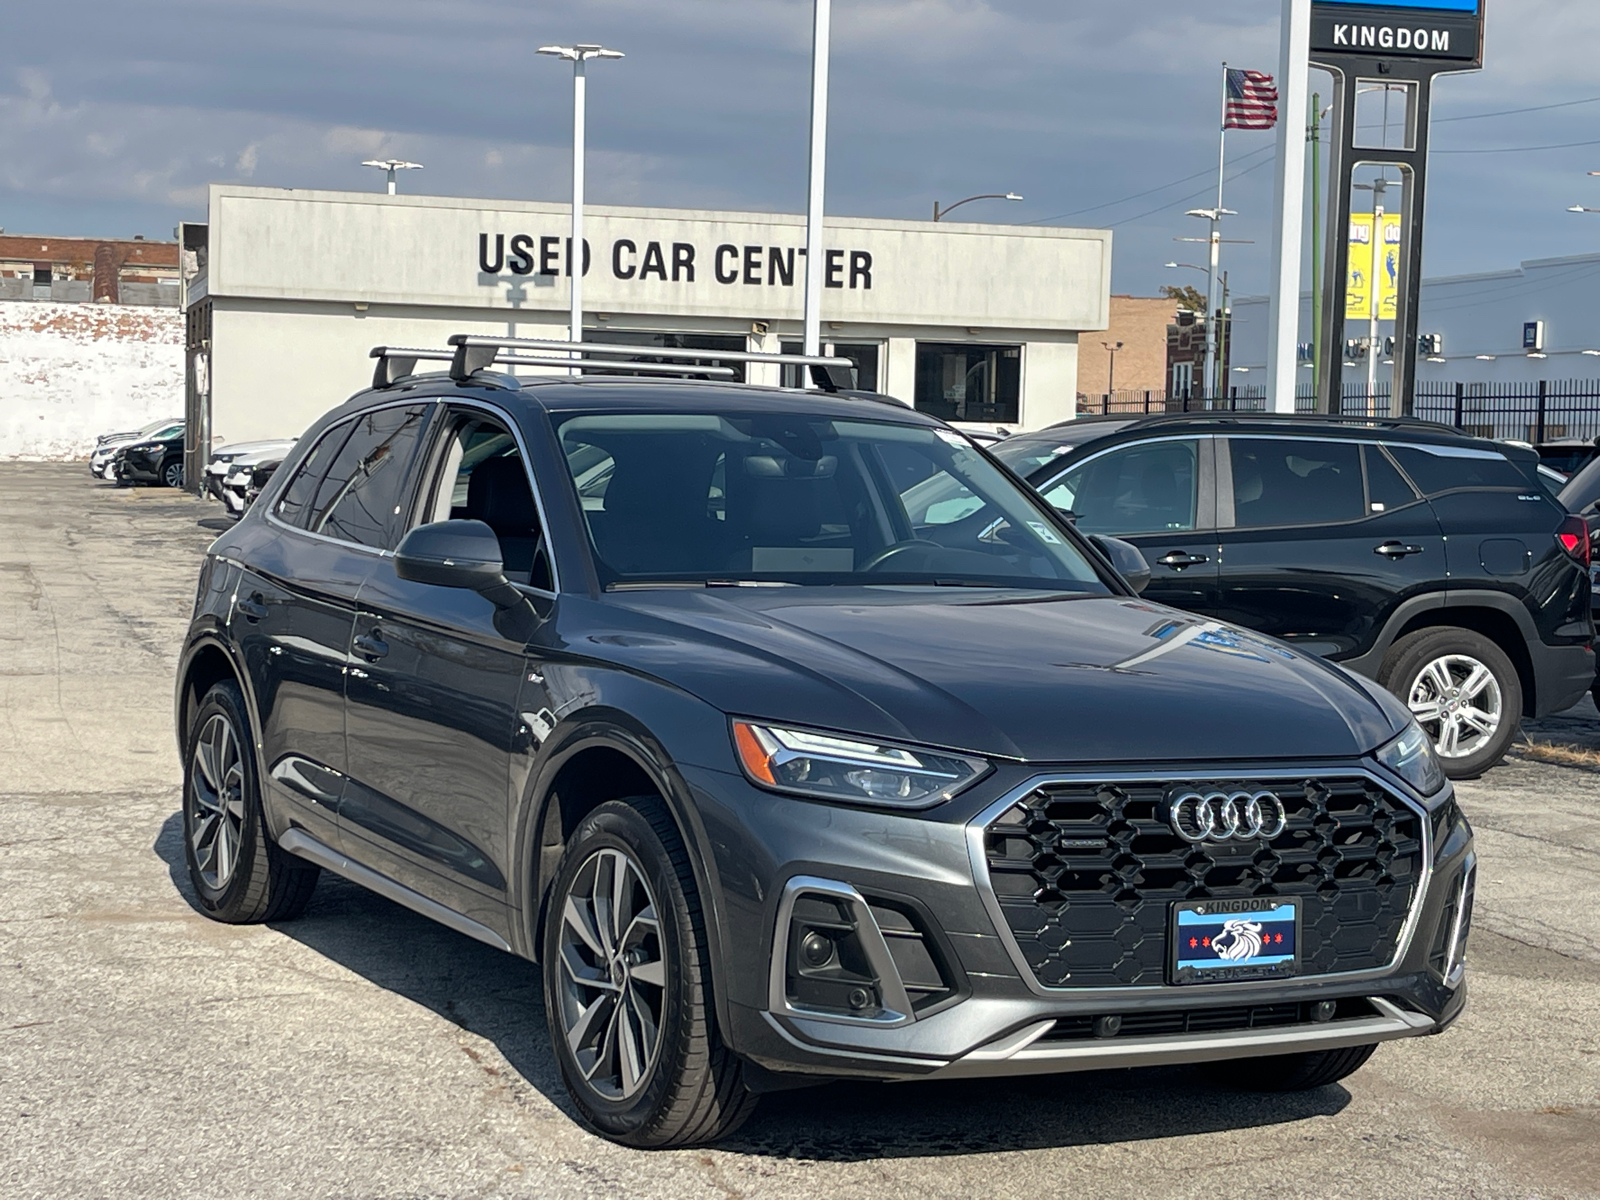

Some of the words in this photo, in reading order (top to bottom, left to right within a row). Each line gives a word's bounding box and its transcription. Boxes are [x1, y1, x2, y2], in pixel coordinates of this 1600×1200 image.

[1333, 24, 1449, 51] KINGDOM
[1349, 222, 1369, 242] ing
[1385, 223, 1400, 242] do
[479, 233, 591, 277] USED
[612, 239, 695, 282] CAR
[1205, 899, 1271, 913] KINGDOM
